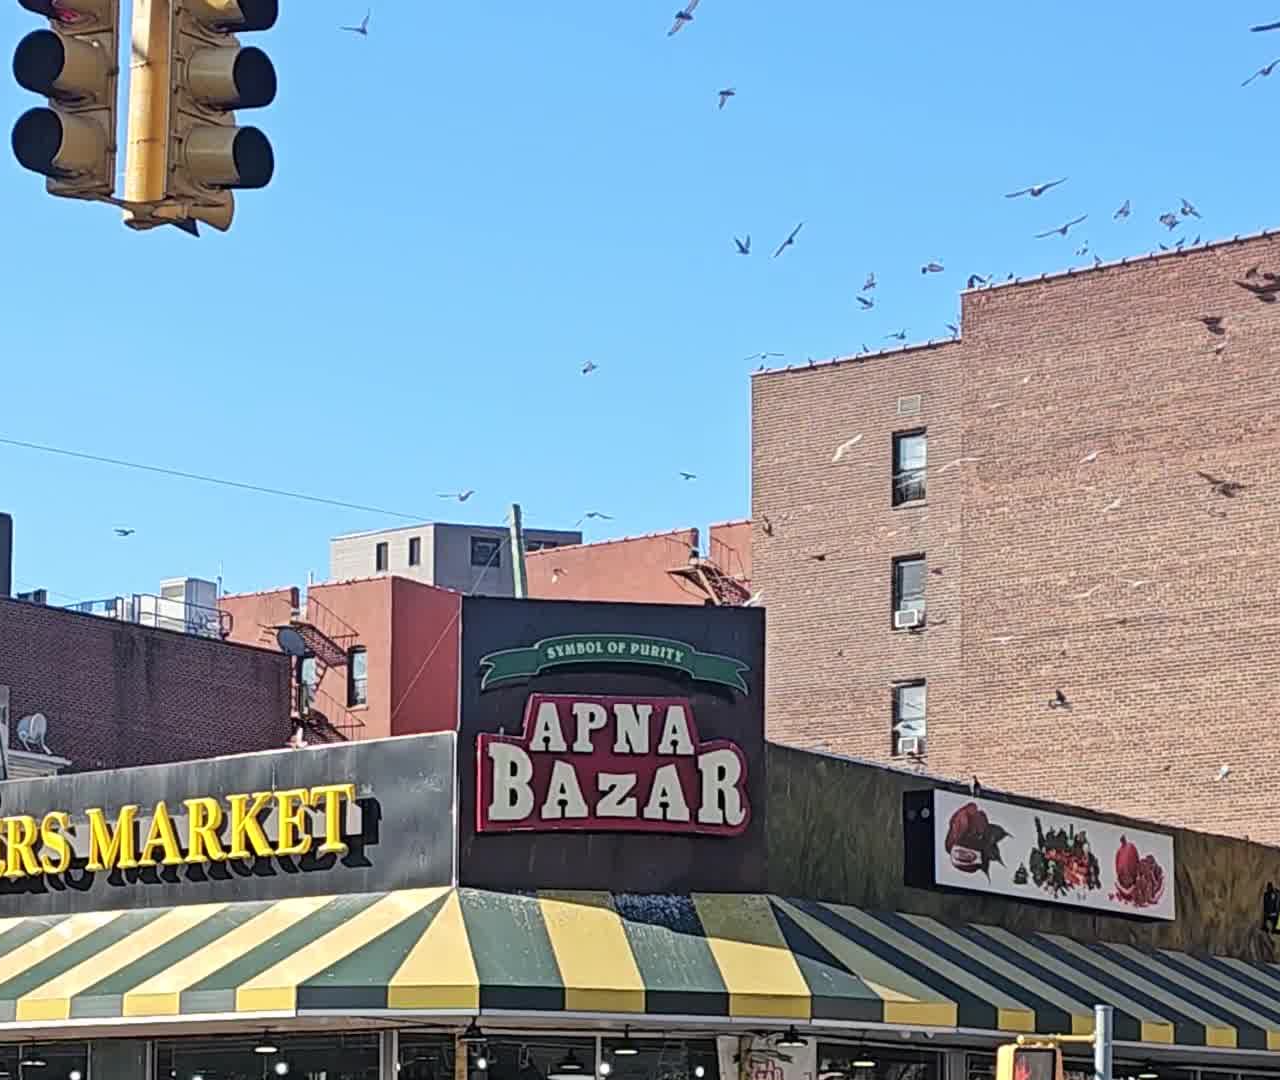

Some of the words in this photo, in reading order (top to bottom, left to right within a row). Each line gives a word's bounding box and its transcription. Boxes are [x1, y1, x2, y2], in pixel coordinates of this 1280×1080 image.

[547, 641, 603, 660] SYMBOL
[608, 641, 626, 654] OF
[630, 642, 685, 663] PURITY
[529, 702, 695, 755] APNA
[487, 742, 747, 826] BAZAR
[86, 783, 357, 872] MARKET
